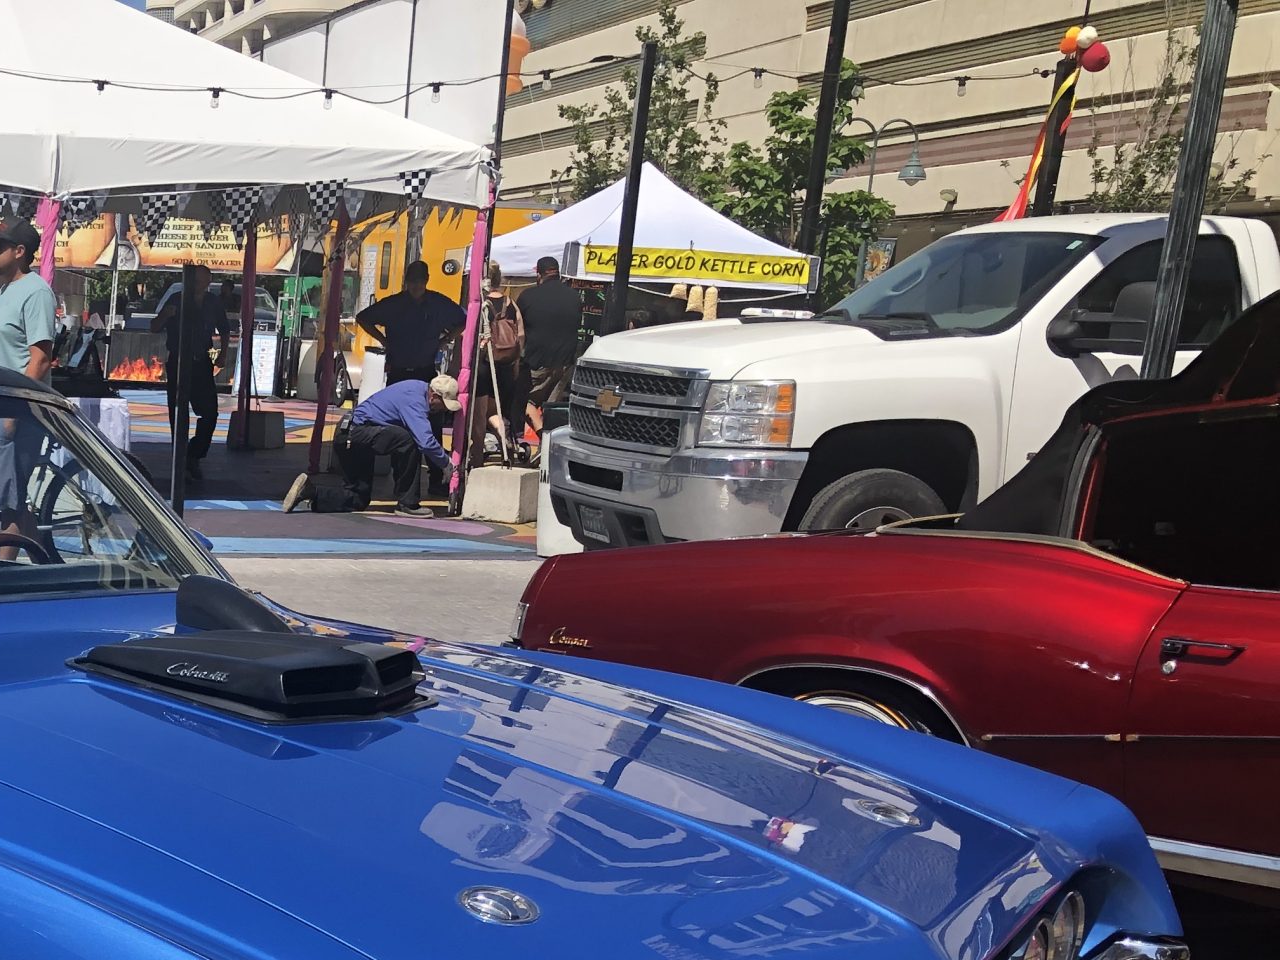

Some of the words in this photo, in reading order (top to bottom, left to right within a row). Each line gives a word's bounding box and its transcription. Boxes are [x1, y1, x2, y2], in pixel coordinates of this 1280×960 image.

[586, 251, 648, 269] PLAER
[653, 256, 695, 271] GOLD
[699, 258, 755, 275] KETTLE
[761, 263, 806, 278] CORN
[166, 662, 208, 678] Cobra
